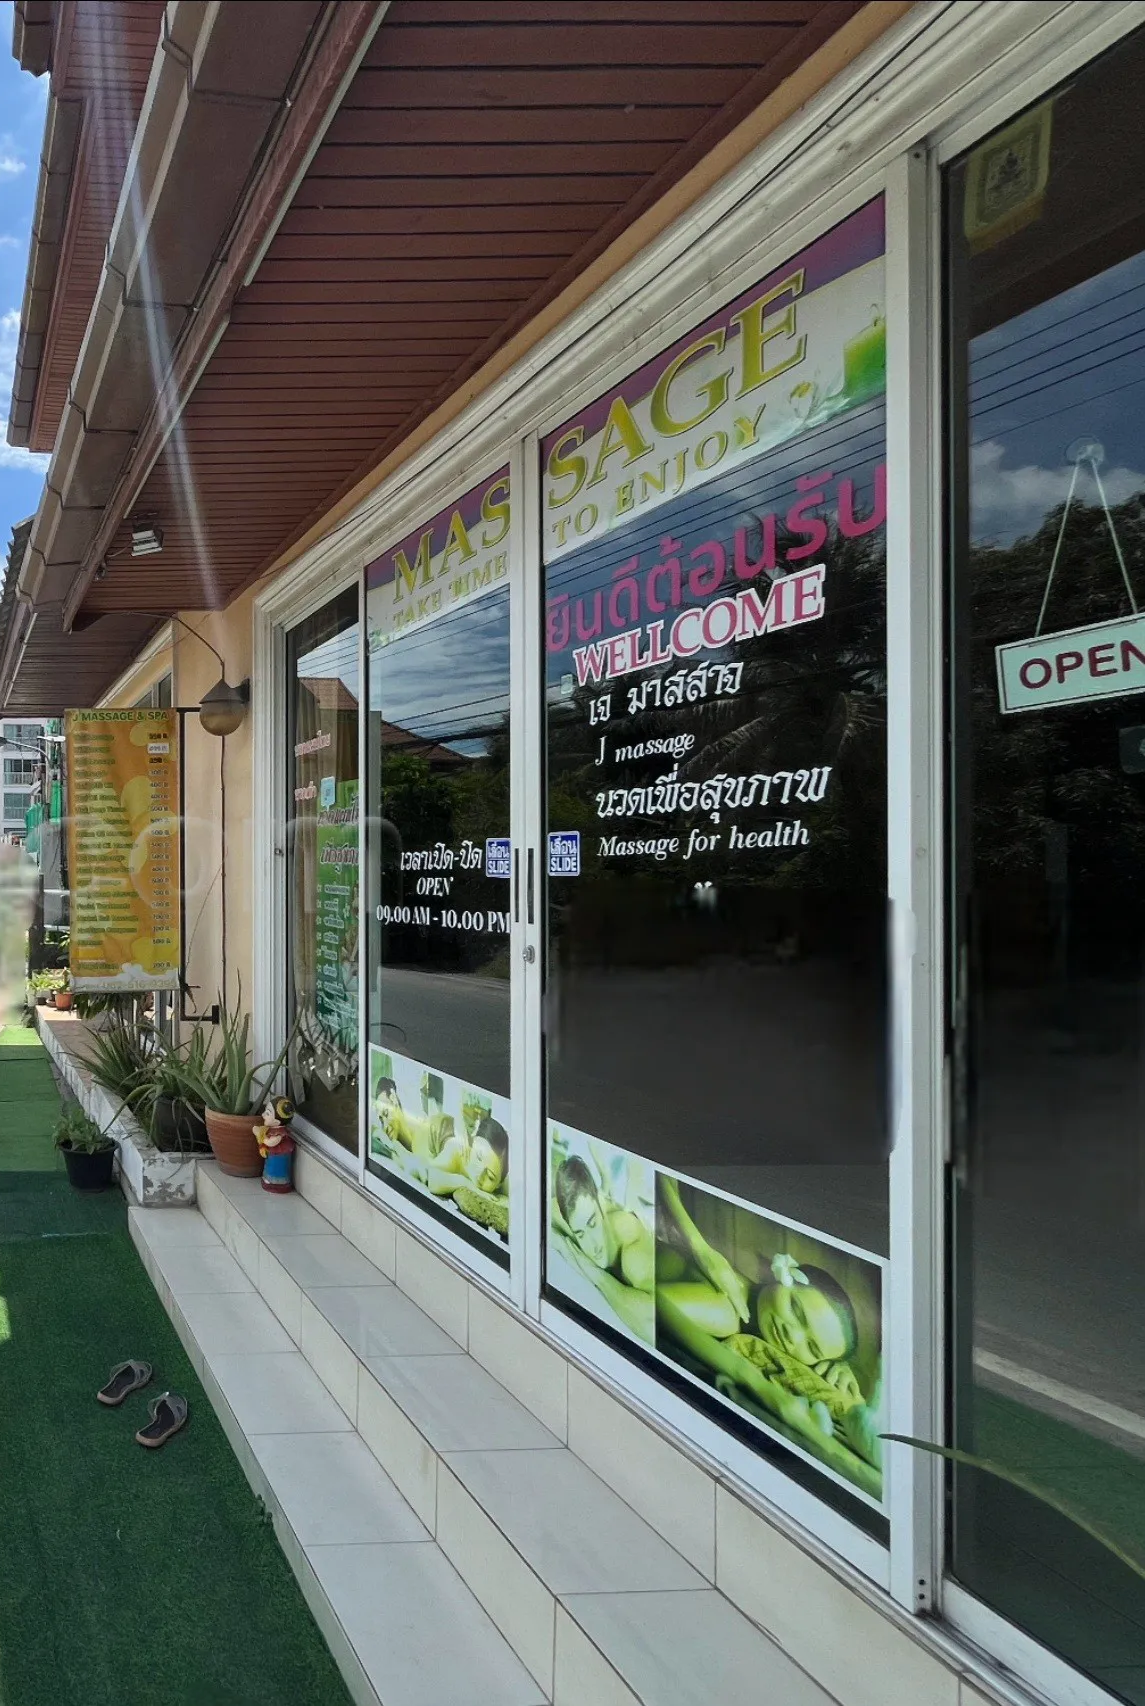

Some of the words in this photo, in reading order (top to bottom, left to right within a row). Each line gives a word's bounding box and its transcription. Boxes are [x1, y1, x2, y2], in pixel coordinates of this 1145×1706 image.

[392, 476, 510, 604] MAS
[548, 268, 808, 508] SAGE
[393, 589, 442, 631] TAKE
[552, 503, 598, 548] TO
[615, 403, 766, 517] ENJOY
[573, 563, 826, 688] WELLCOME
[589, 694, 611, 726] เจ
[627, 661, 744, 715] มาสสาจ
[81, 711, 133, 721] MASSAGE
[147, 711, 168, 720] SPA
[595, 737, 607, 765] J
[615, 732, 695, 762] massage
[596, 763, 832, 824] นวดเพื่อสุขภาพ
[400, 840, 483, 871] เวลาเปิด-ปิด
[597, 836, 679, 860] Massage
[683, 828, 721, 860] for
[728, 820, 810, 849] health
[488, 860, 509, 874] SLIDE
[550, 857, 577, 872] SLIDE
[416, 876, 454, 897] OPEN
[376, 905, 410, 925] 09.00
[412, 906, 431, 926] AM
[441, 909, 484, 931] 10.00
[487, 911, 510, 934] PM
